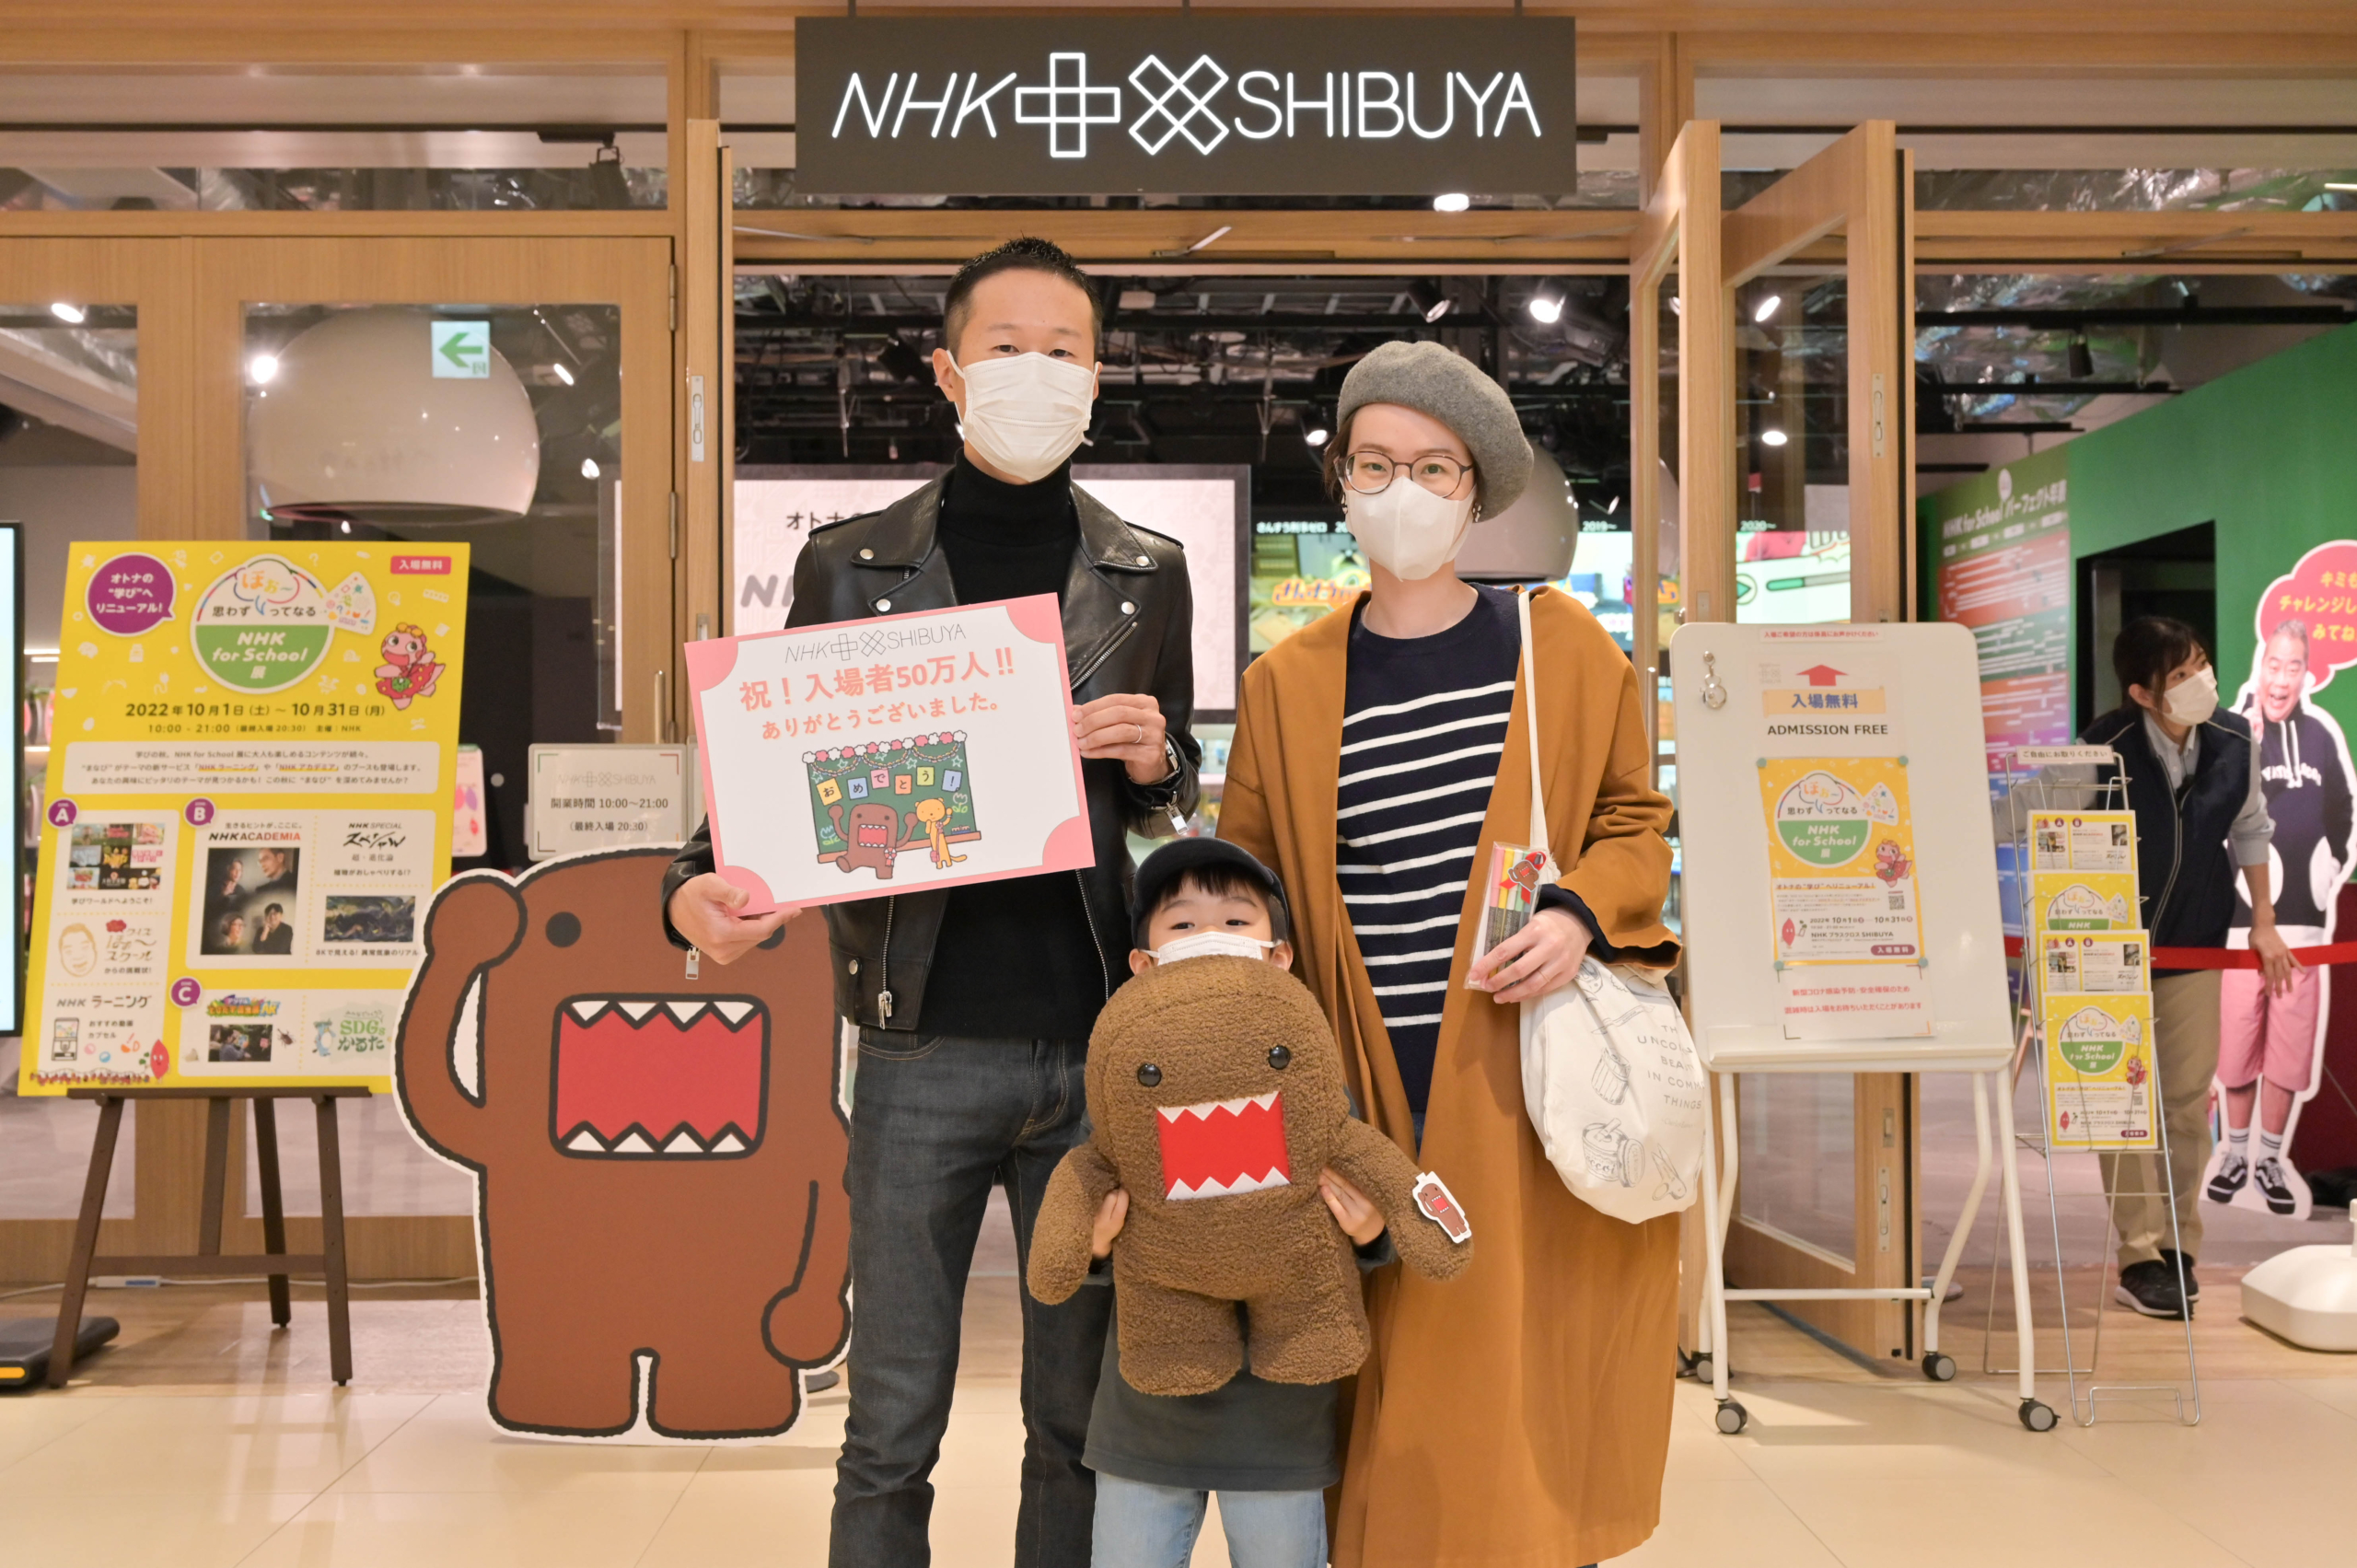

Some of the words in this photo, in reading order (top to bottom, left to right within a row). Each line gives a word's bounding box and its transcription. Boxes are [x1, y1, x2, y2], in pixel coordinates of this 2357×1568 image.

[831, 71, 1017, 139] NHK
[1234, 71, 1542, 139] SHIBUYA
[786, 511, 863, 530] オトナ
[399, 559, 444, 570] 入場無料
[110, 573, 155, 584] オトナの
[212, 606, 250, 617] 思わず
[270, 606, 316, 617] ってなる
[237, 632, 286, 645] NHK
[784, 641, 830, 664] NHK
[887, 623, 967, 650] SHIBUYA
[212, 647, 240, 662] for
[242, 647, 308, 662] School
[250, 666, 267, 679] 展
[1792, 693, 1859, 709] 入場無料
[761, 691, 999, 740] ありがとうございました。
[148, 724, 181, 733] 10:00
[196, 724, 230, 733] 21:00
[1768, 725, 1850, 736] ADMISSION
[1854, 725, 1889, 735] FREE
[2023, 750, 2107, 759] ご自由にお取りください
[612, 774, 656, 785] SHIBUYA
[55, 807, 69, 822] A
[193, 807, 205, 821] B
[1787, 807, 1813, 815] 思わず
[1826, 807, 1858, 815] ってなる
[1807, 825, 1840, 835] NHK
[1793, 836, 1811, 846] for
[1814, 835, 1857, 846] School
[179, 986, 192, 1002] C
[56, 998, 87, 1007] NHK
[91, 994, 153, 1008] ラーニング
[340, 1020, 387, 1036] SDGs
[338, 1036, 385, 1052] かるた
[1647, 1070, 1661, 1082] IN
[1663, 1094, 1702, 1109] THINGS
